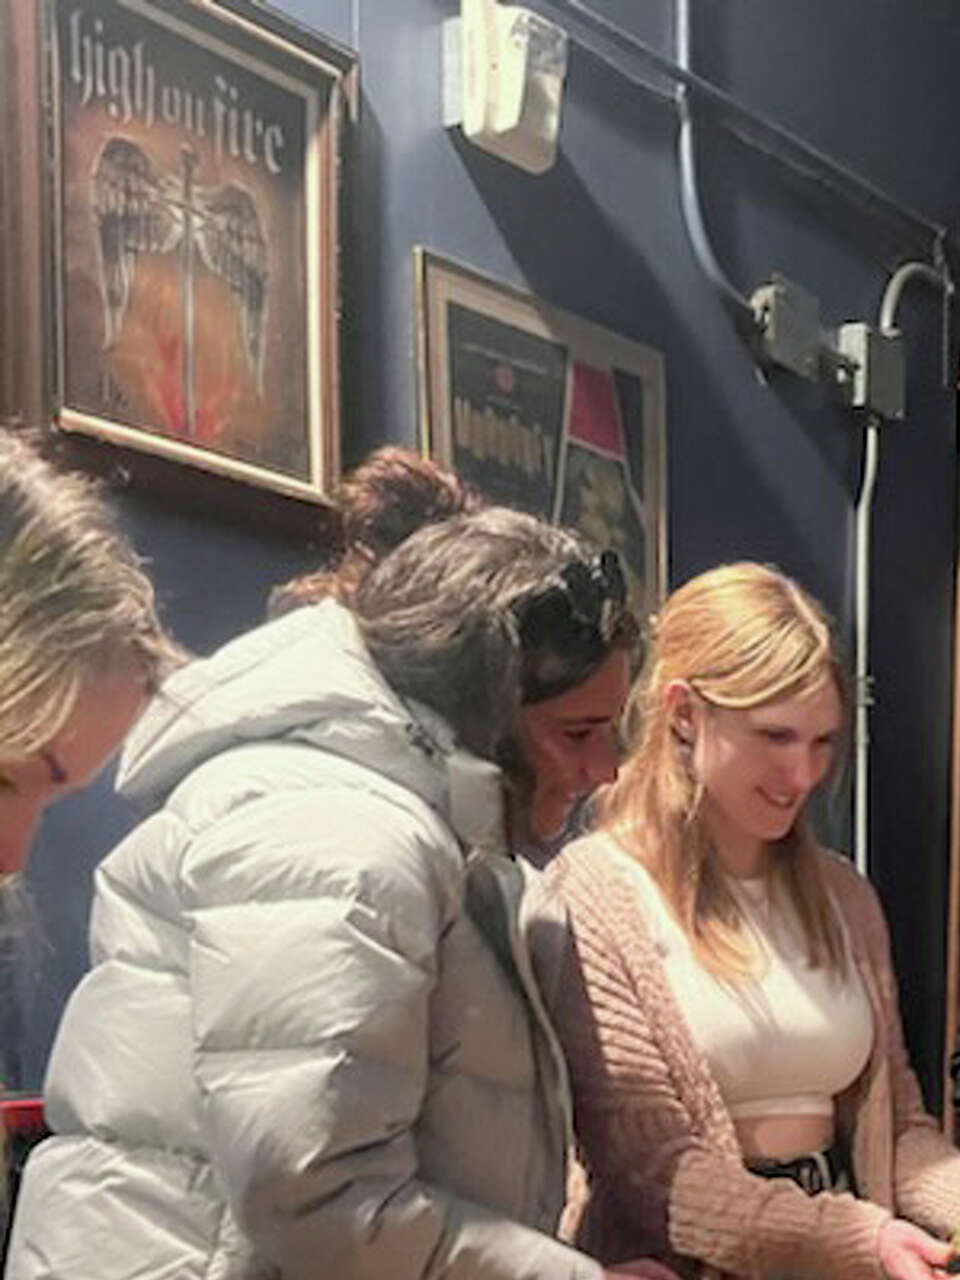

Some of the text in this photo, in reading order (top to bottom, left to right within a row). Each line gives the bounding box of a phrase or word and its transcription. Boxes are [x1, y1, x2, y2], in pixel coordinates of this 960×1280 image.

[70, 10, 285, 174] high on fire
